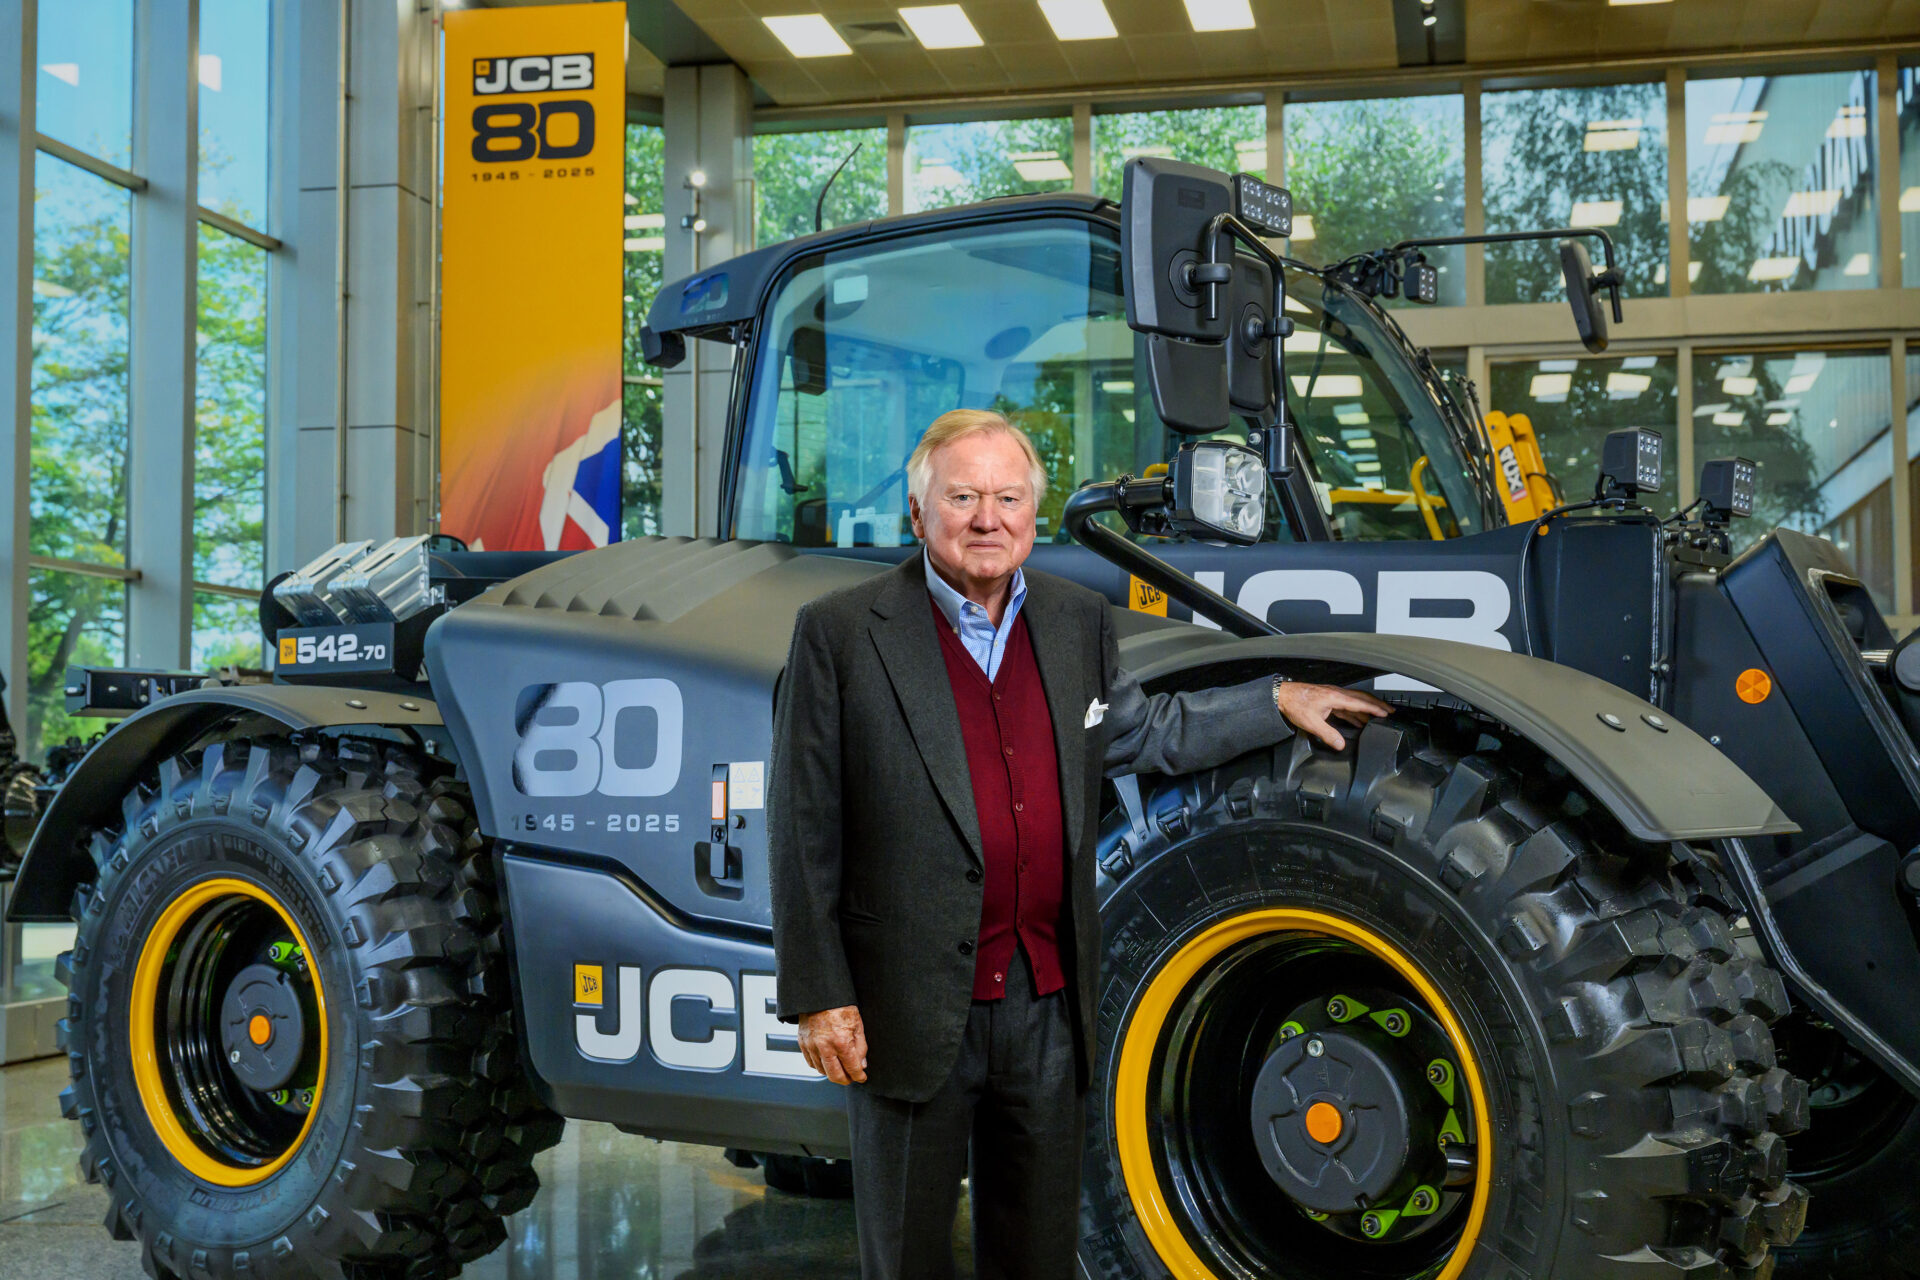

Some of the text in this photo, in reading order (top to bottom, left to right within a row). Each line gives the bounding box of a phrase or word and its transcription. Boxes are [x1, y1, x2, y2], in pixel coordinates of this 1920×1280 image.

[475, 54, 593, 94] JCB
[471, 99, 595, 163] 80
[472, 171, 520, 182] 1945
[543, 167, 595, 179] 2025
[512, 678, 684, 797] 80
[607, 814, 680, 832] 2025
